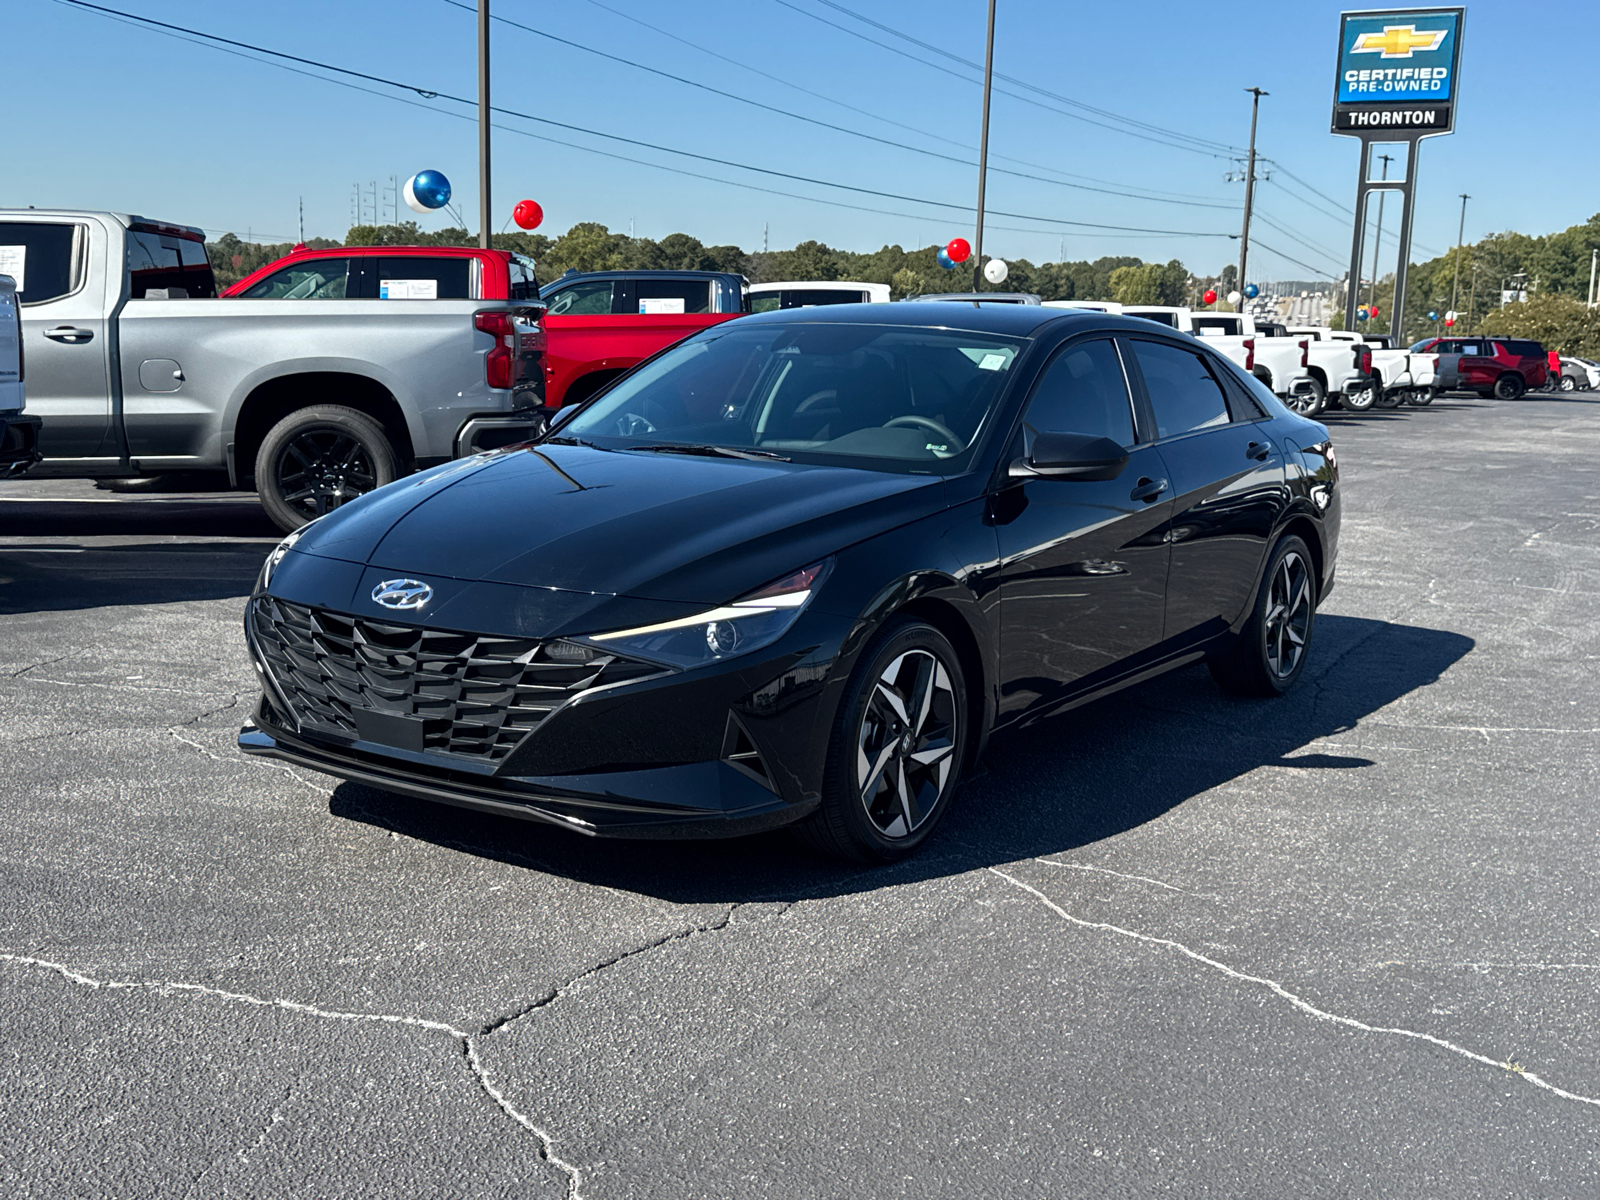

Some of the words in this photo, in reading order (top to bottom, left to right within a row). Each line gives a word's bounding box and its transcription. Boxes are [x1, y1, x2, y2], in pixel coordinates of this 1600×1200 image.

[1345, 67, 1447, 81] CERTIFIED
[1348, 80, 1441, 93] PRE-OWNED
[1349, 110, 1435, 125] THORNTON
